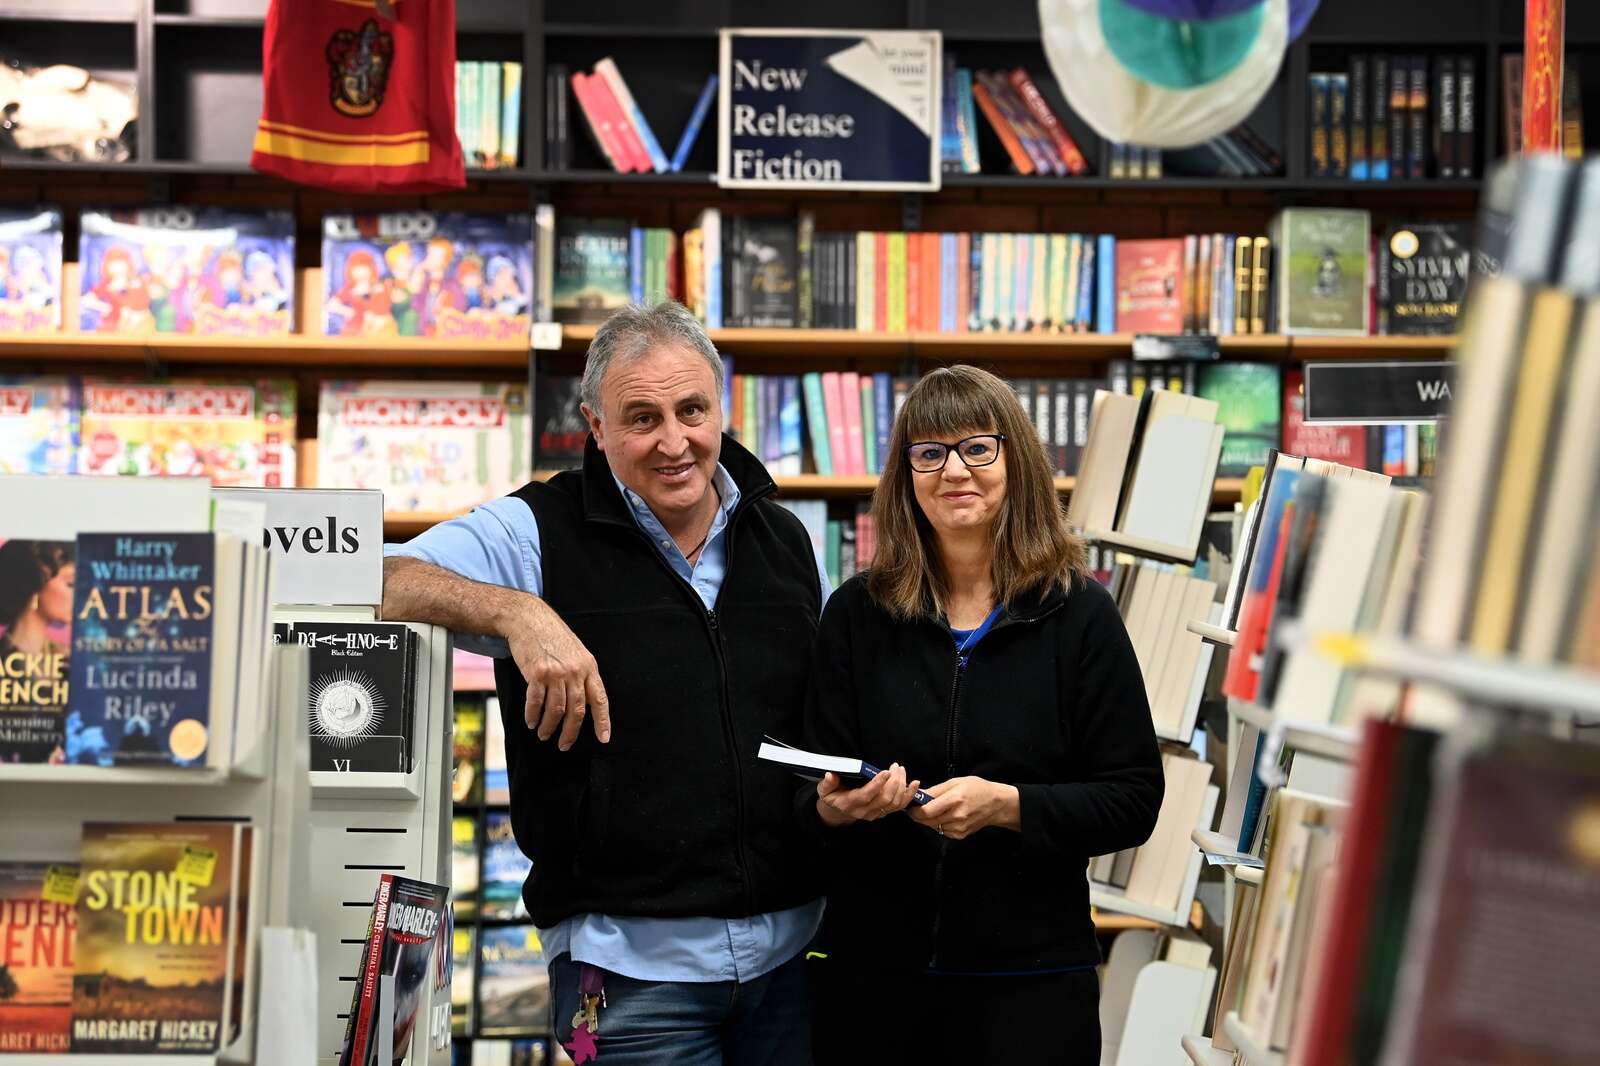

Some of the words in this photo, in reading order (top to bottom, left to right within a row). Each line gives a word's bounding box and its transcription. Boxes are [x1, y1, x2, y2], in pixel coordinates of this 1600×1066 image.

[735, 59, 808, 92] New
[734, 103, 856, 138] Release
[734, 148, 842, 179] Fiction
[116, 537, 178, 562] Harry
[91, 561, 201, 581] Whittaker
[79, 585, 212, 620] ATLAS
[86, 664, 198, 689] Lucinda
[104, 696, 176, 728] Riley
[332, 759, 352, 773] VI
[86, 870, 200, 910] STONE
[123, 904, 224, 945] TOWN
[74, 1020, 157, 1041] MARGARET
[160, 1020, 218, 1041] HICKEY
